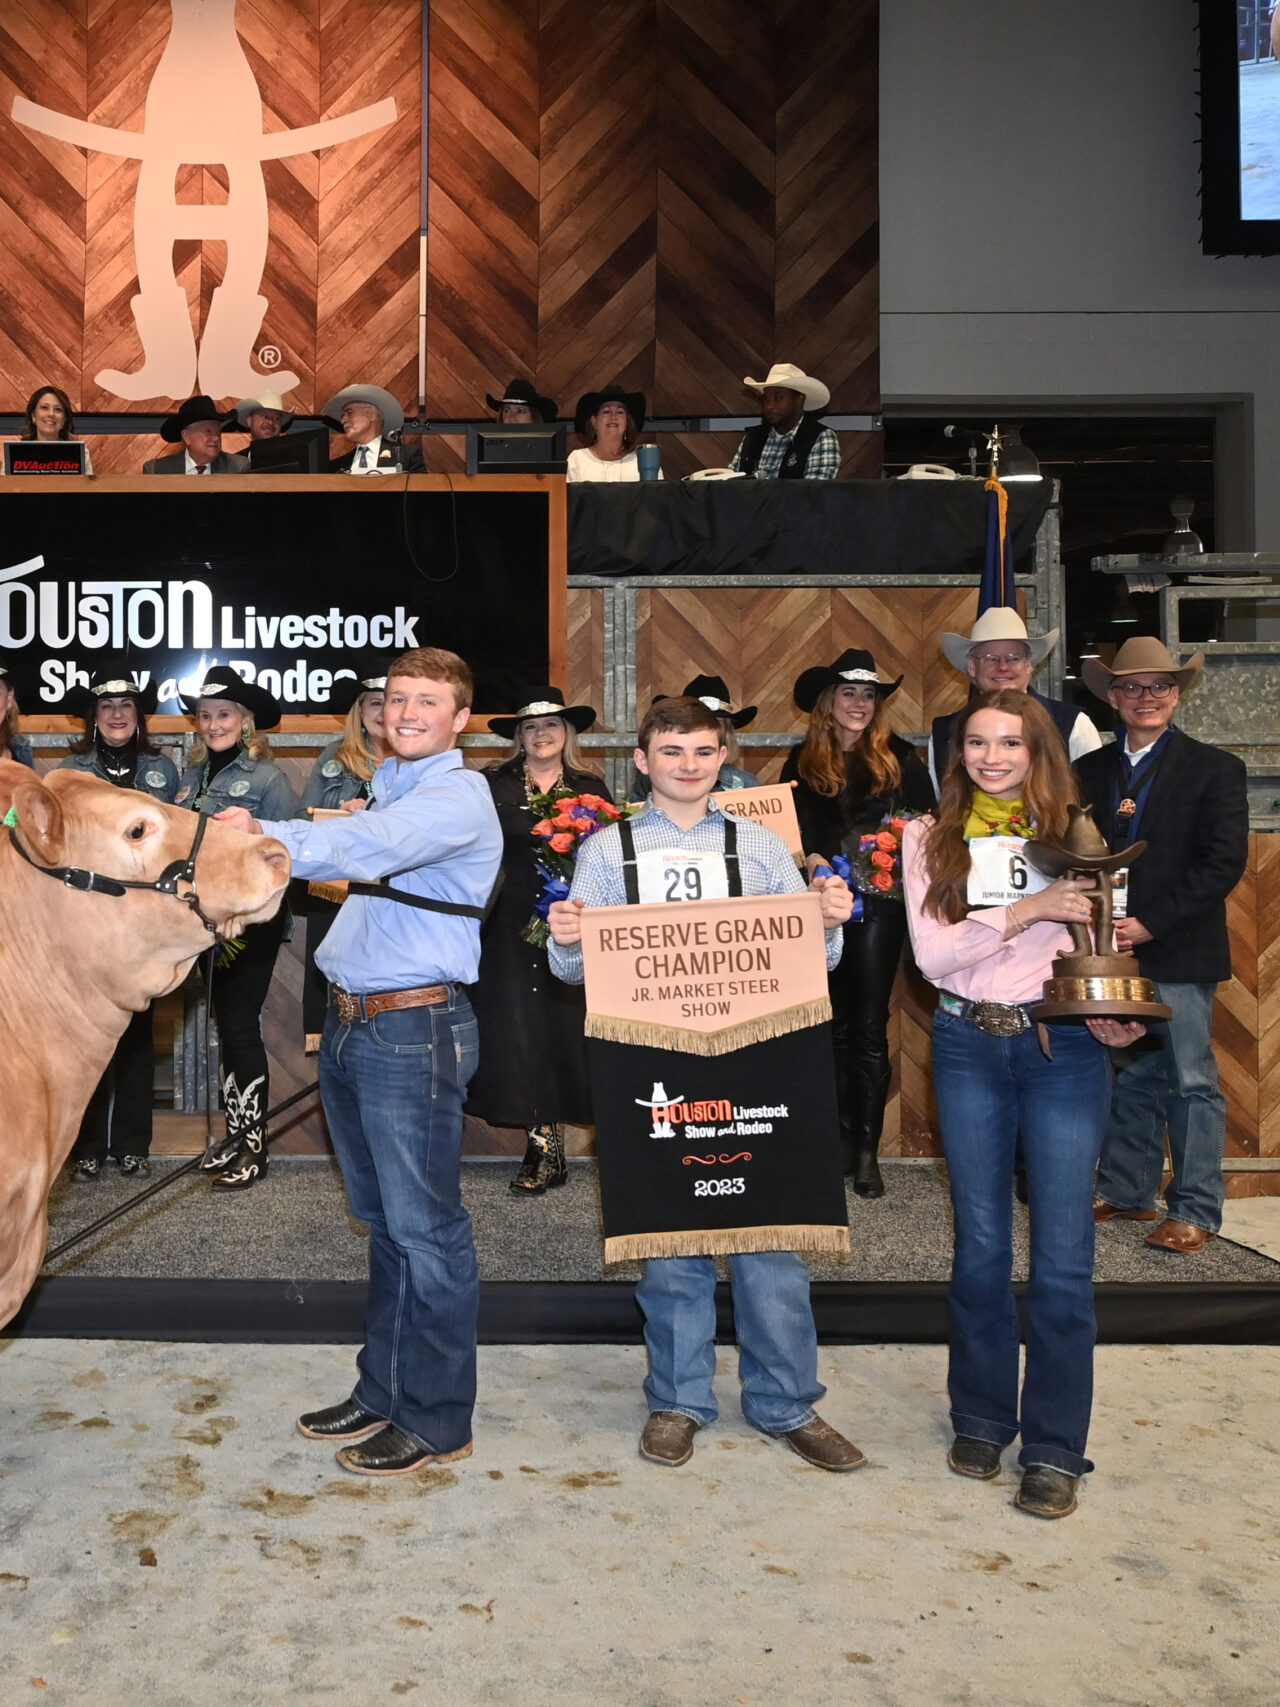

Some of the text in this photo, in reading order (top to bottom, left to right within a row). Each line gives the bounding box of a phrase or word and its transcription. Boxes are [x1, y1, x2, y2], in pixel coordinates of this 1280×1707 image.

[13, 460, 79, 471] DVAuction
[220, 606, 420, 649] Livestock
[39, 659, 151, 703] Sh
[724, 798, 782, 817] GRAND
[1008, 855, 1028, 890] 6
[663, 867, 703, 902] 29
[982, 891, 1005, 899] JUNIOR
[599, 915, 804, 952] RESERVE GRAND
[635, 947, 772, 980] CHAMPION
[631, 978, 780, 1002] JR. MARKET STEER
[681, 1001, 731, 1018] SHOW
[733, 1104, 789, 1120] Livestock
[684, 1121, 773, 1139] Show and Rodeo
[694, 1177, 746, 1197] 2023
